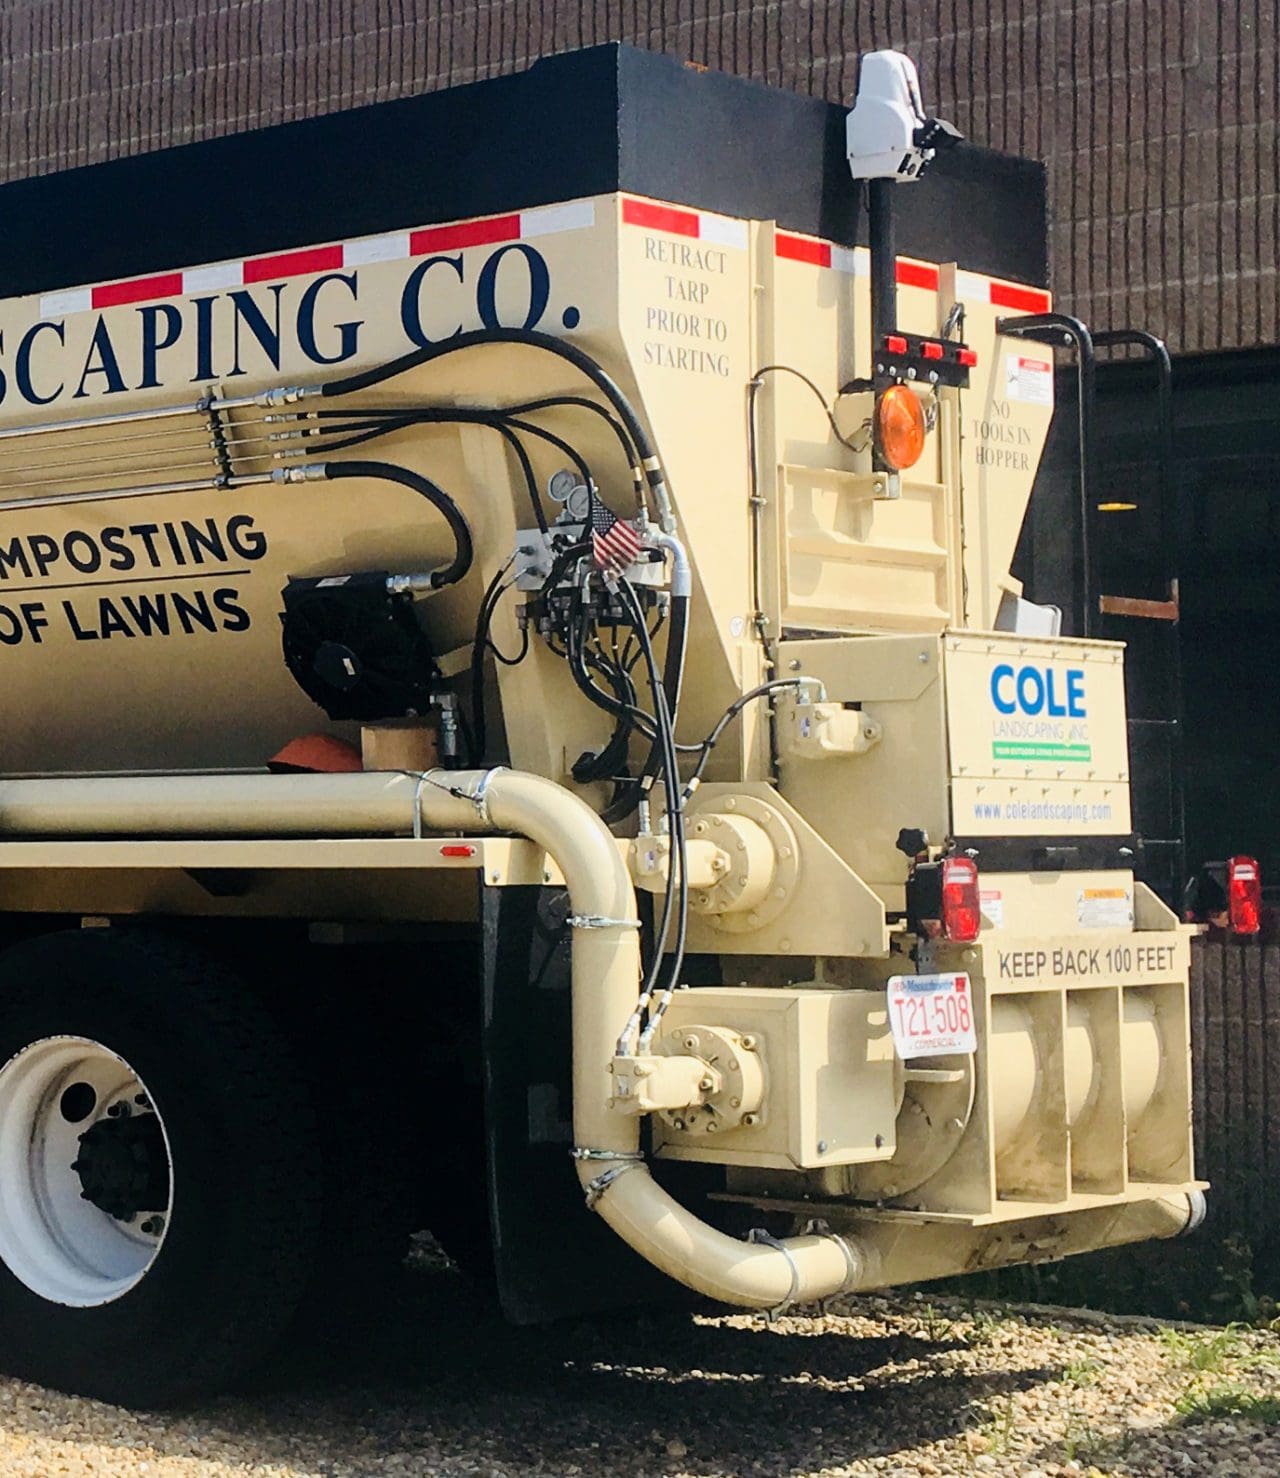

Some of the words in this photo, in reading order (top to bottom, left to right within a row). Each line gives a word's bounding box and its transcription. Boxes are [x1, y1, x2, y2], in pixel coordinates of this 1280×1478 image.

[644, 237, 727, 274] RETRACT
[401, 243, 581, 347] CO.
[665, 276, 709, 304] TARP
[646, 307, 700, 338] PRIOR
[704, 318, 727, 342] TO
[644, 342, 729, 377] STARTING
[992, 400, 1010, 418] NO
[973, 420, 1015, 443] TOOLS
[1017, 426, 1031, 444] IN
[975, 446, 1029, 470] HOPPER
[62, 588, 251, 640] LAWNS
[990, 664, 1087, 718] COLE
[974, 800, 1112, 823] www.colelandscaping.com
[1000, 950, 1046, 978] KEEP
[1053, 949, 1100, 976] BACK
[1106, 948, 1132, 973] 100
[1137, 946, 1176, 971] FEET
